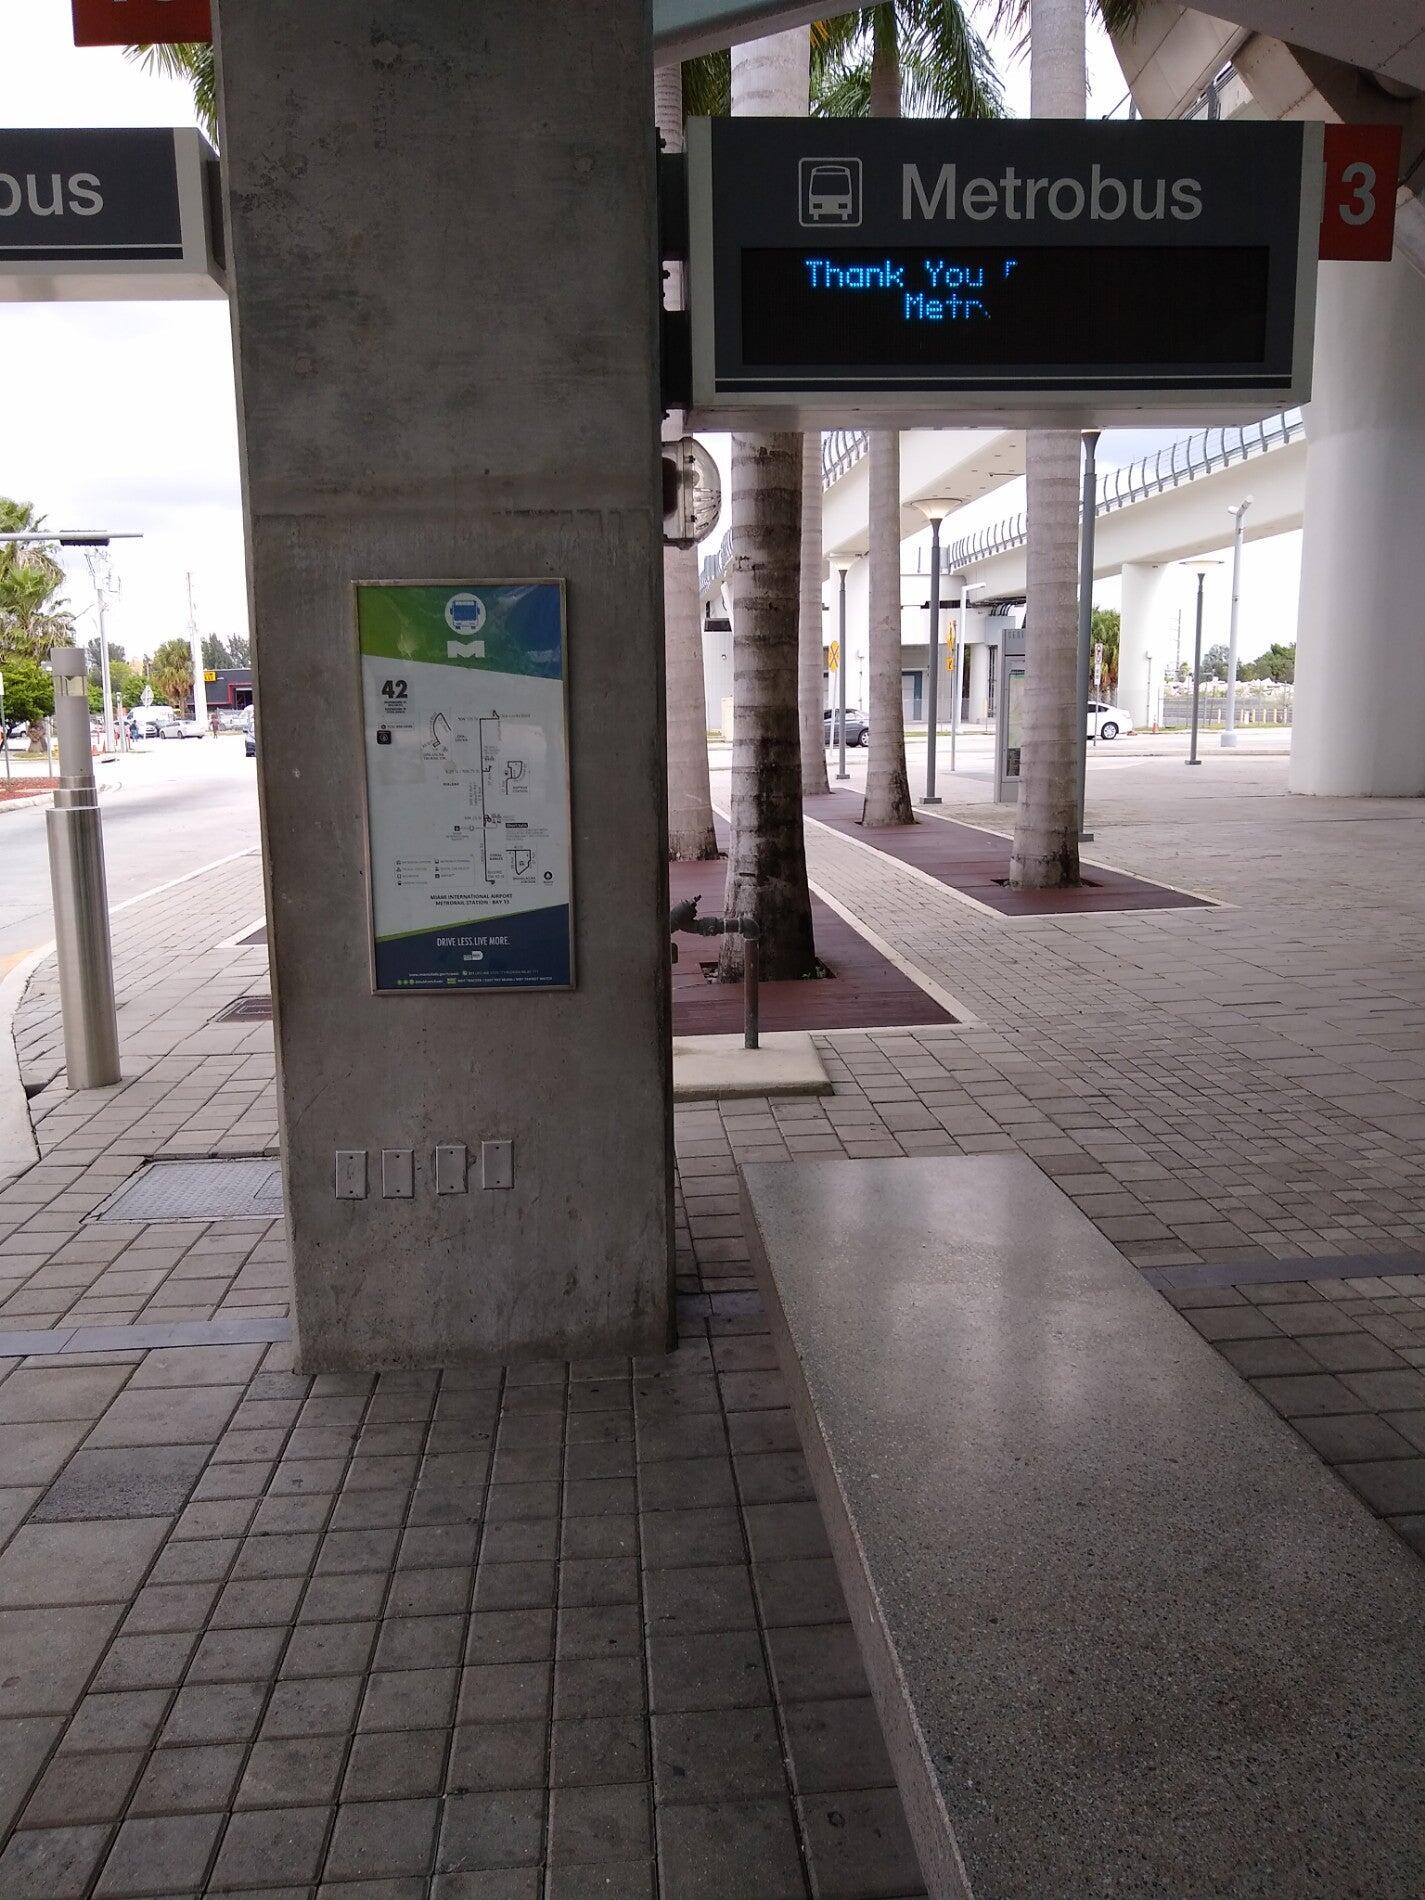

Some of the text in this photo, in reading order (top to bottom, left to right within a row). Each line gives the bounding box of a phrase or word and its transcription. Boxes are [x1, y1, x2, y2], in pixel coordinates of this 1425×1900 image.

[901, 163, 1204, 221] Metrobus
[1322, 161, 1377, 226] 3
[805, 259, 904, 288] Thank
[925, 259, 985, 288] You
[905, 293, 992, 320] Metr
[381, 679, 408, 699] 42
[437, 937, 456, 947] DRIVE
[475, 936, 488, 946] LIVE
[489, 936, 510, 946] MORE.
